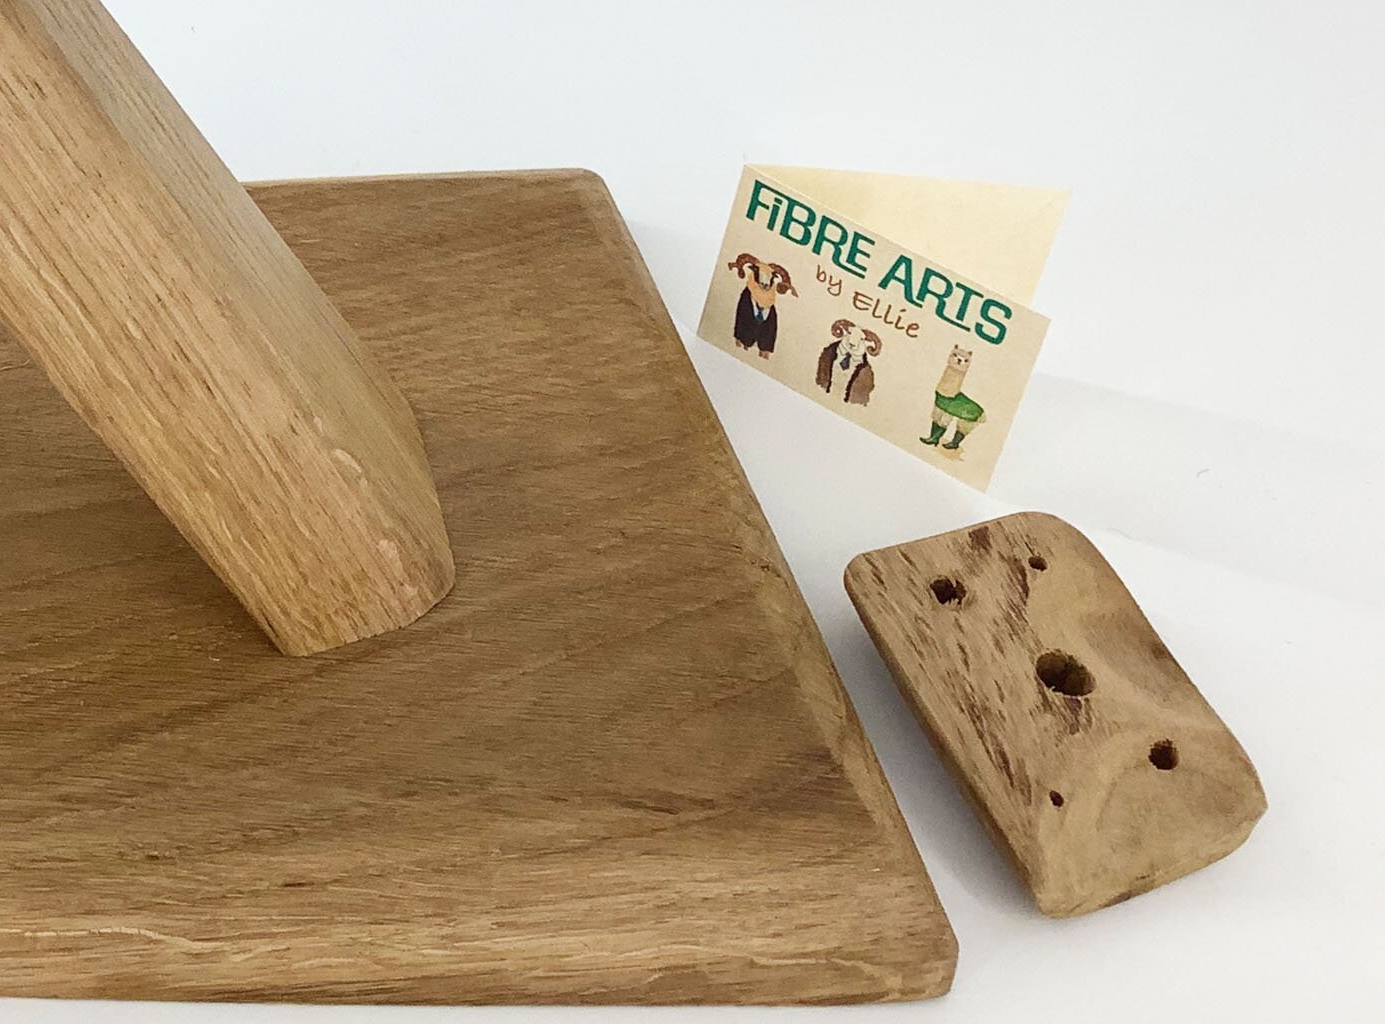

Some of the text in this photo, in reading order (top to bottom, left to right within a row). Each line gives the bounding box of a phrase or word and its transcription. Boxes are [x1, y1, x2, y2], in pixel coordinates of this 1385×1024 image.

[816, 264, 920, 338] by Ellie
[878, 254, 1012, 345] ARTS
